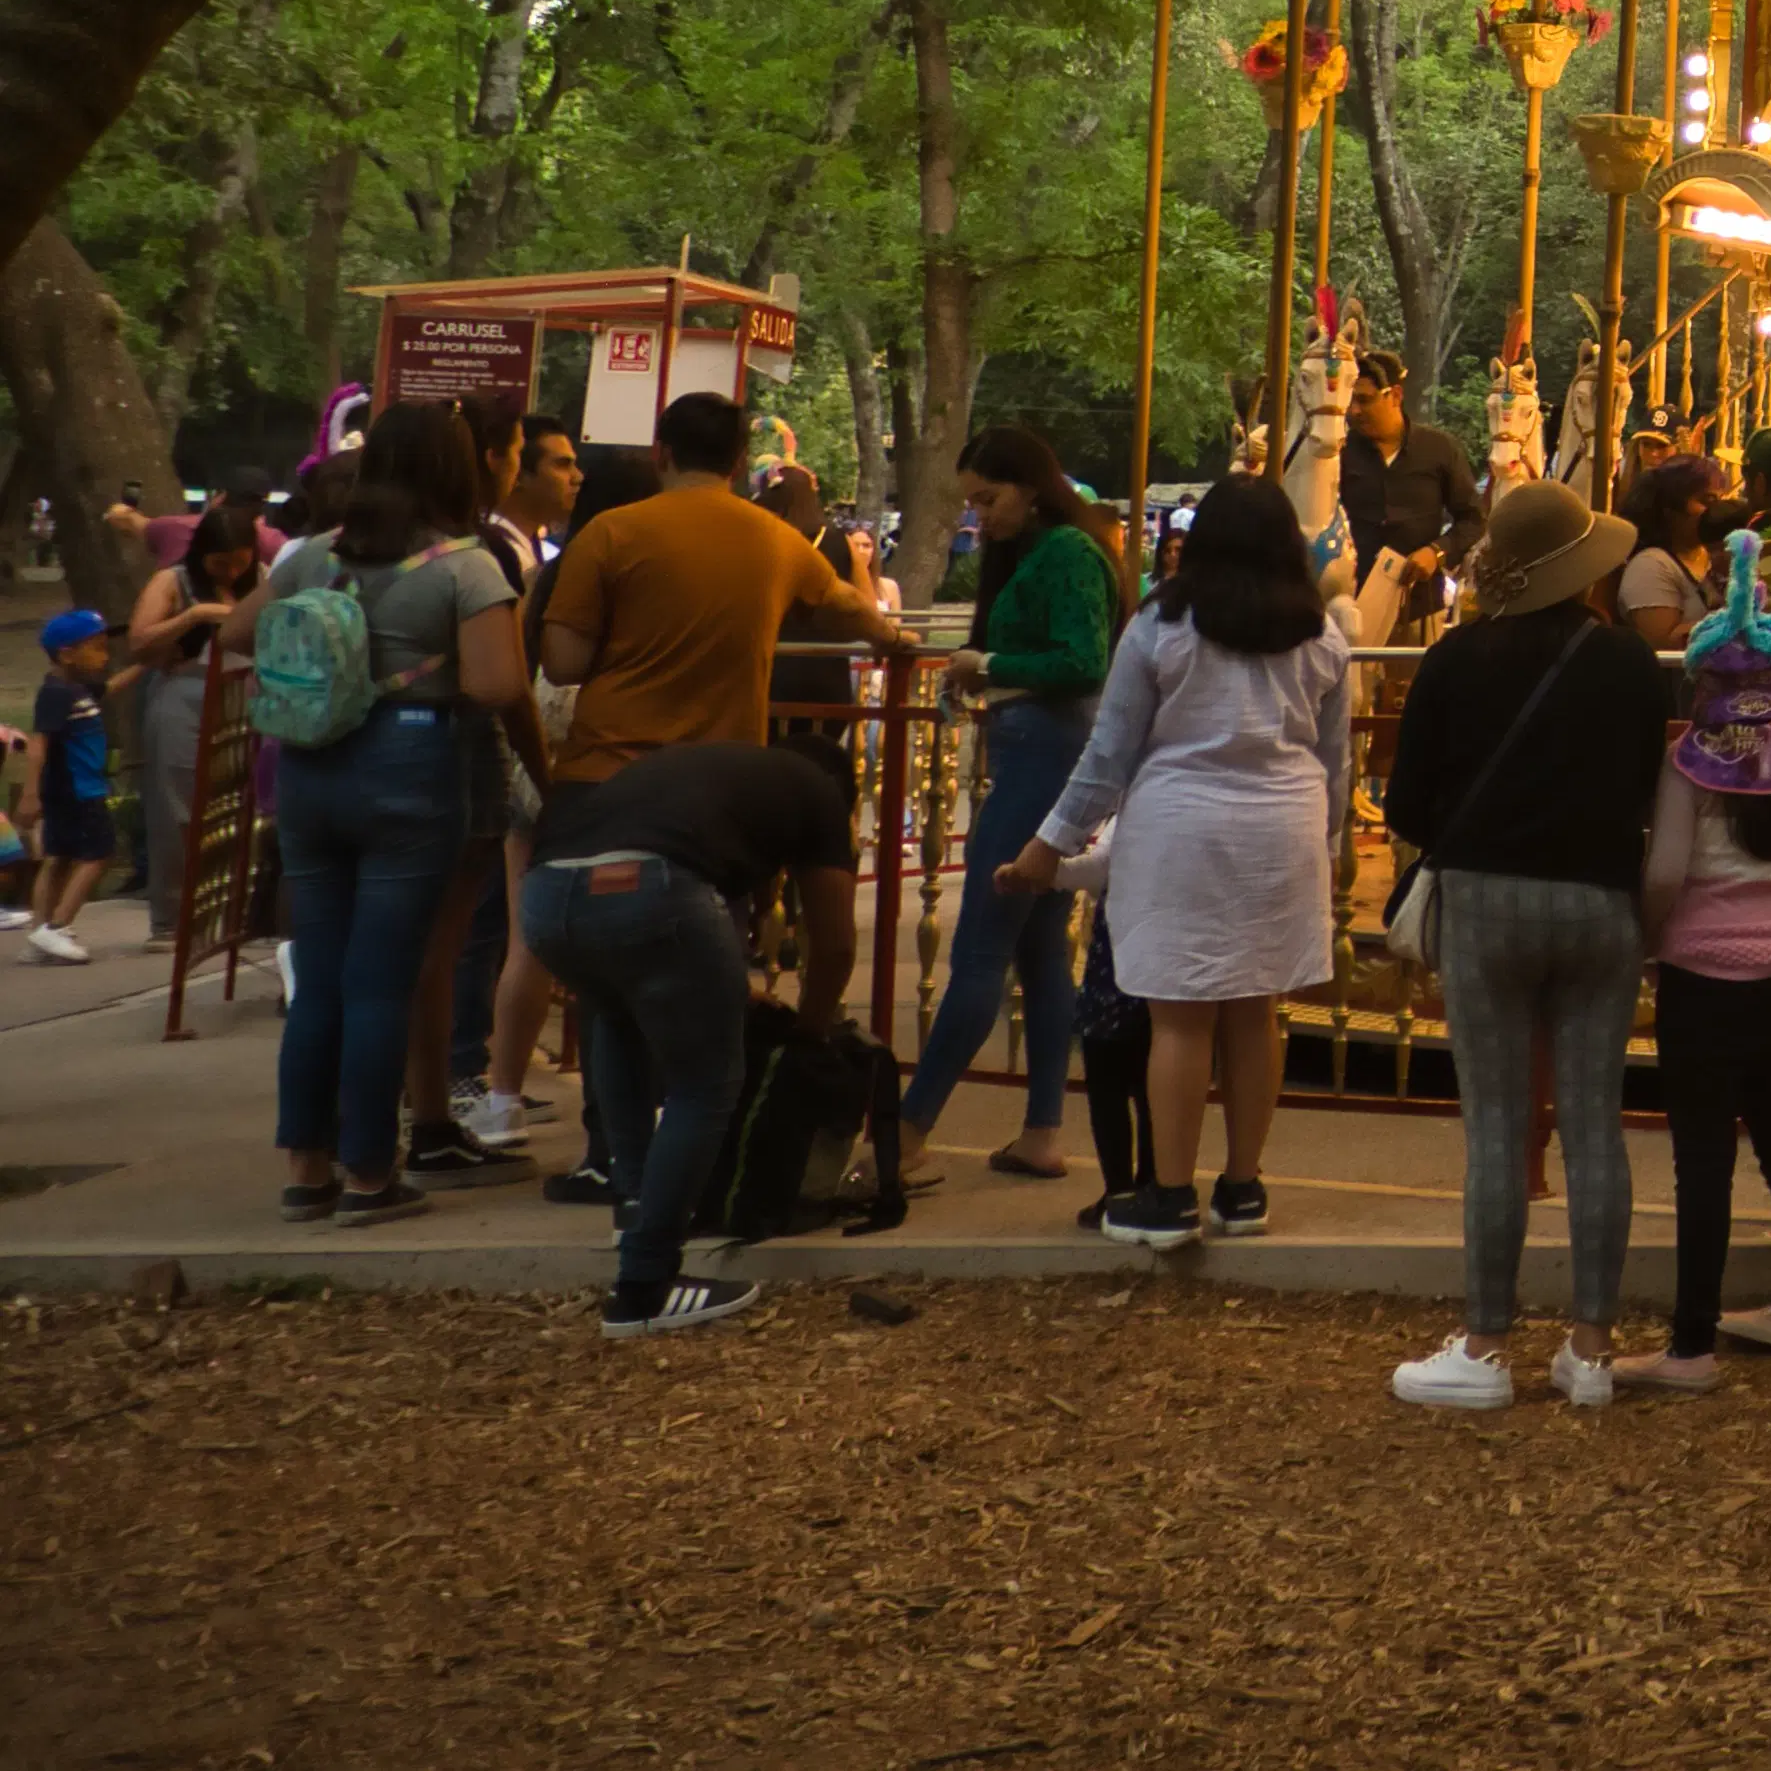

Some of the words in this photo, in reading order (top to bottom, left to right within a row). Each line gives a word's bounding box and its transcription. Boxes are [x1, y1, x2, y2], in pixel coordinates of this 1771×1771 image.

[421, 322, 507, 339] CARRUSEL
[749, 310, 795, 346] SALIDA
[442, 342, 466, 353] POR
[469, 342, 522, 355] PERSONA
